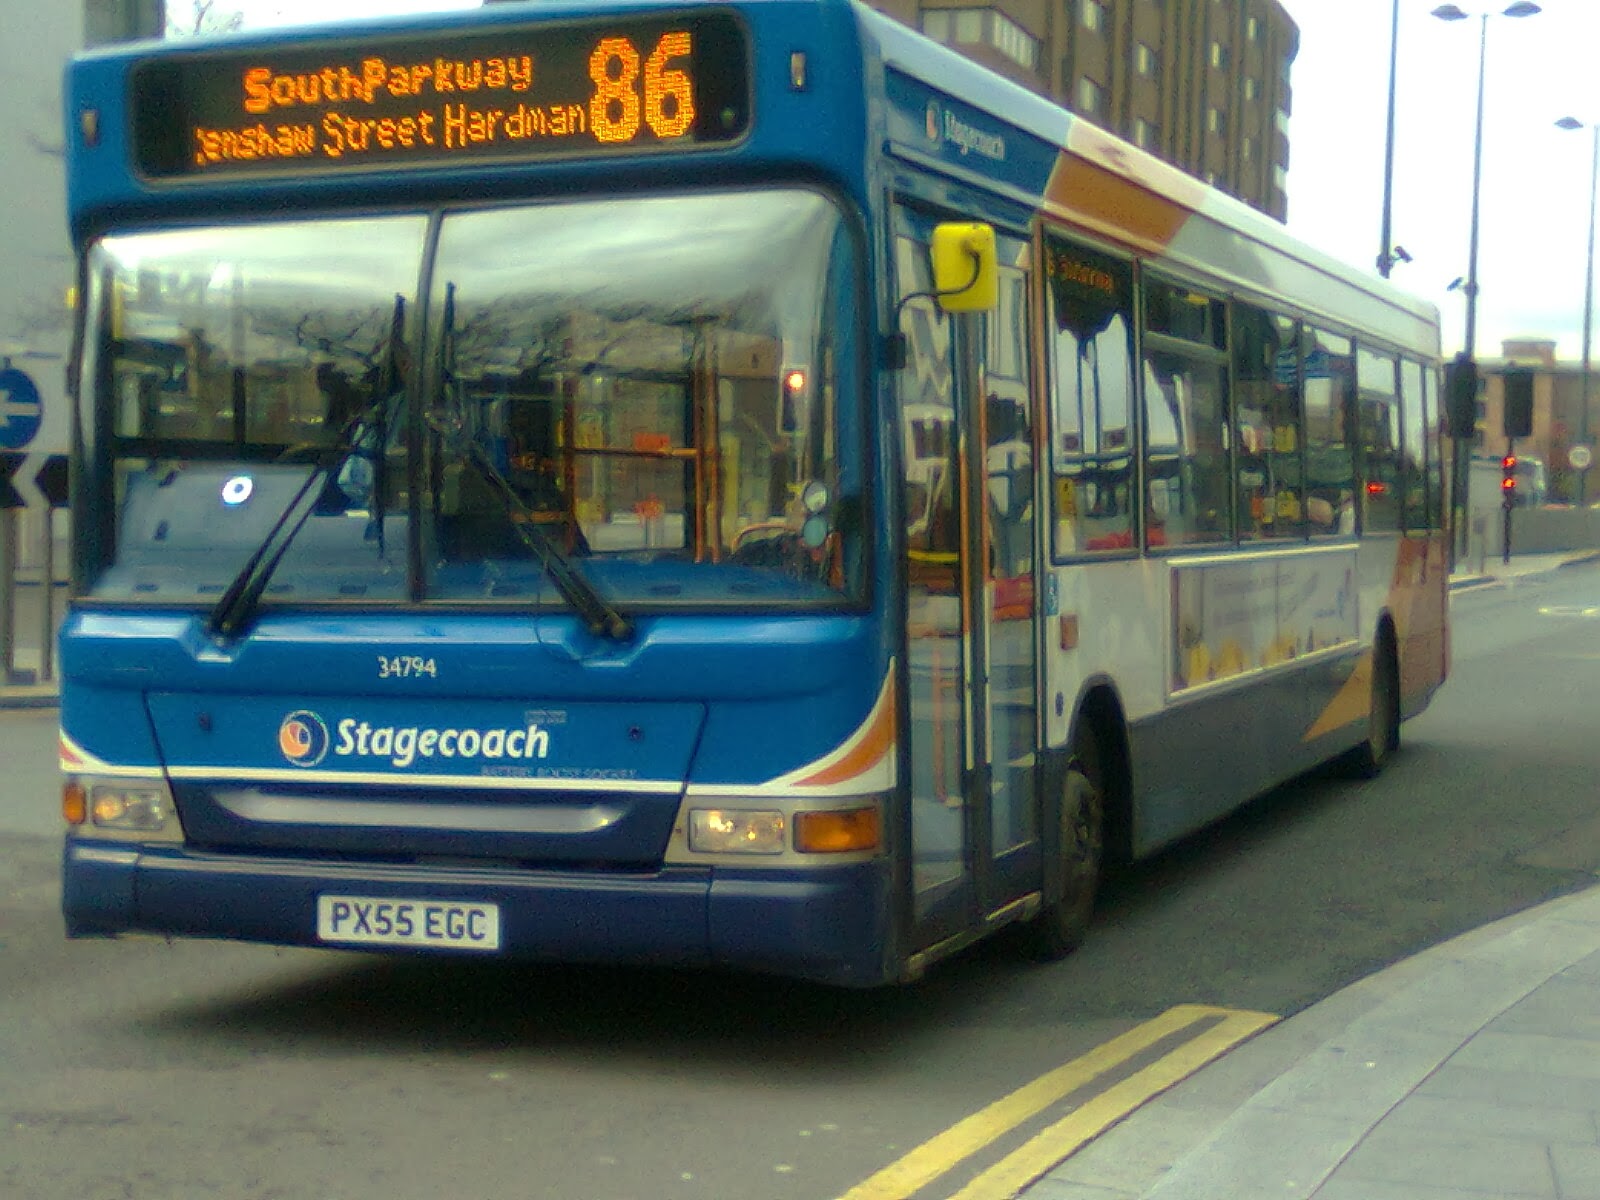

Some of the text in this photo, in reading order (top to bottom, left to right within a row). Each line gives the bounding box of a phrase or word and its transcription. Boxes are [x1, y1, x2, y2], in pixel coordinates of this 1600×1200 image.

[588, 31, 694, 143] 86
[321, 111, 434, 157] Street
[444, 103, 585, 149] Hardman
[377, 655, 437, 679] 34794
[335, 718, 549, 768] Stagecoach
[332, 902, 486, 941] PX55 EGC
